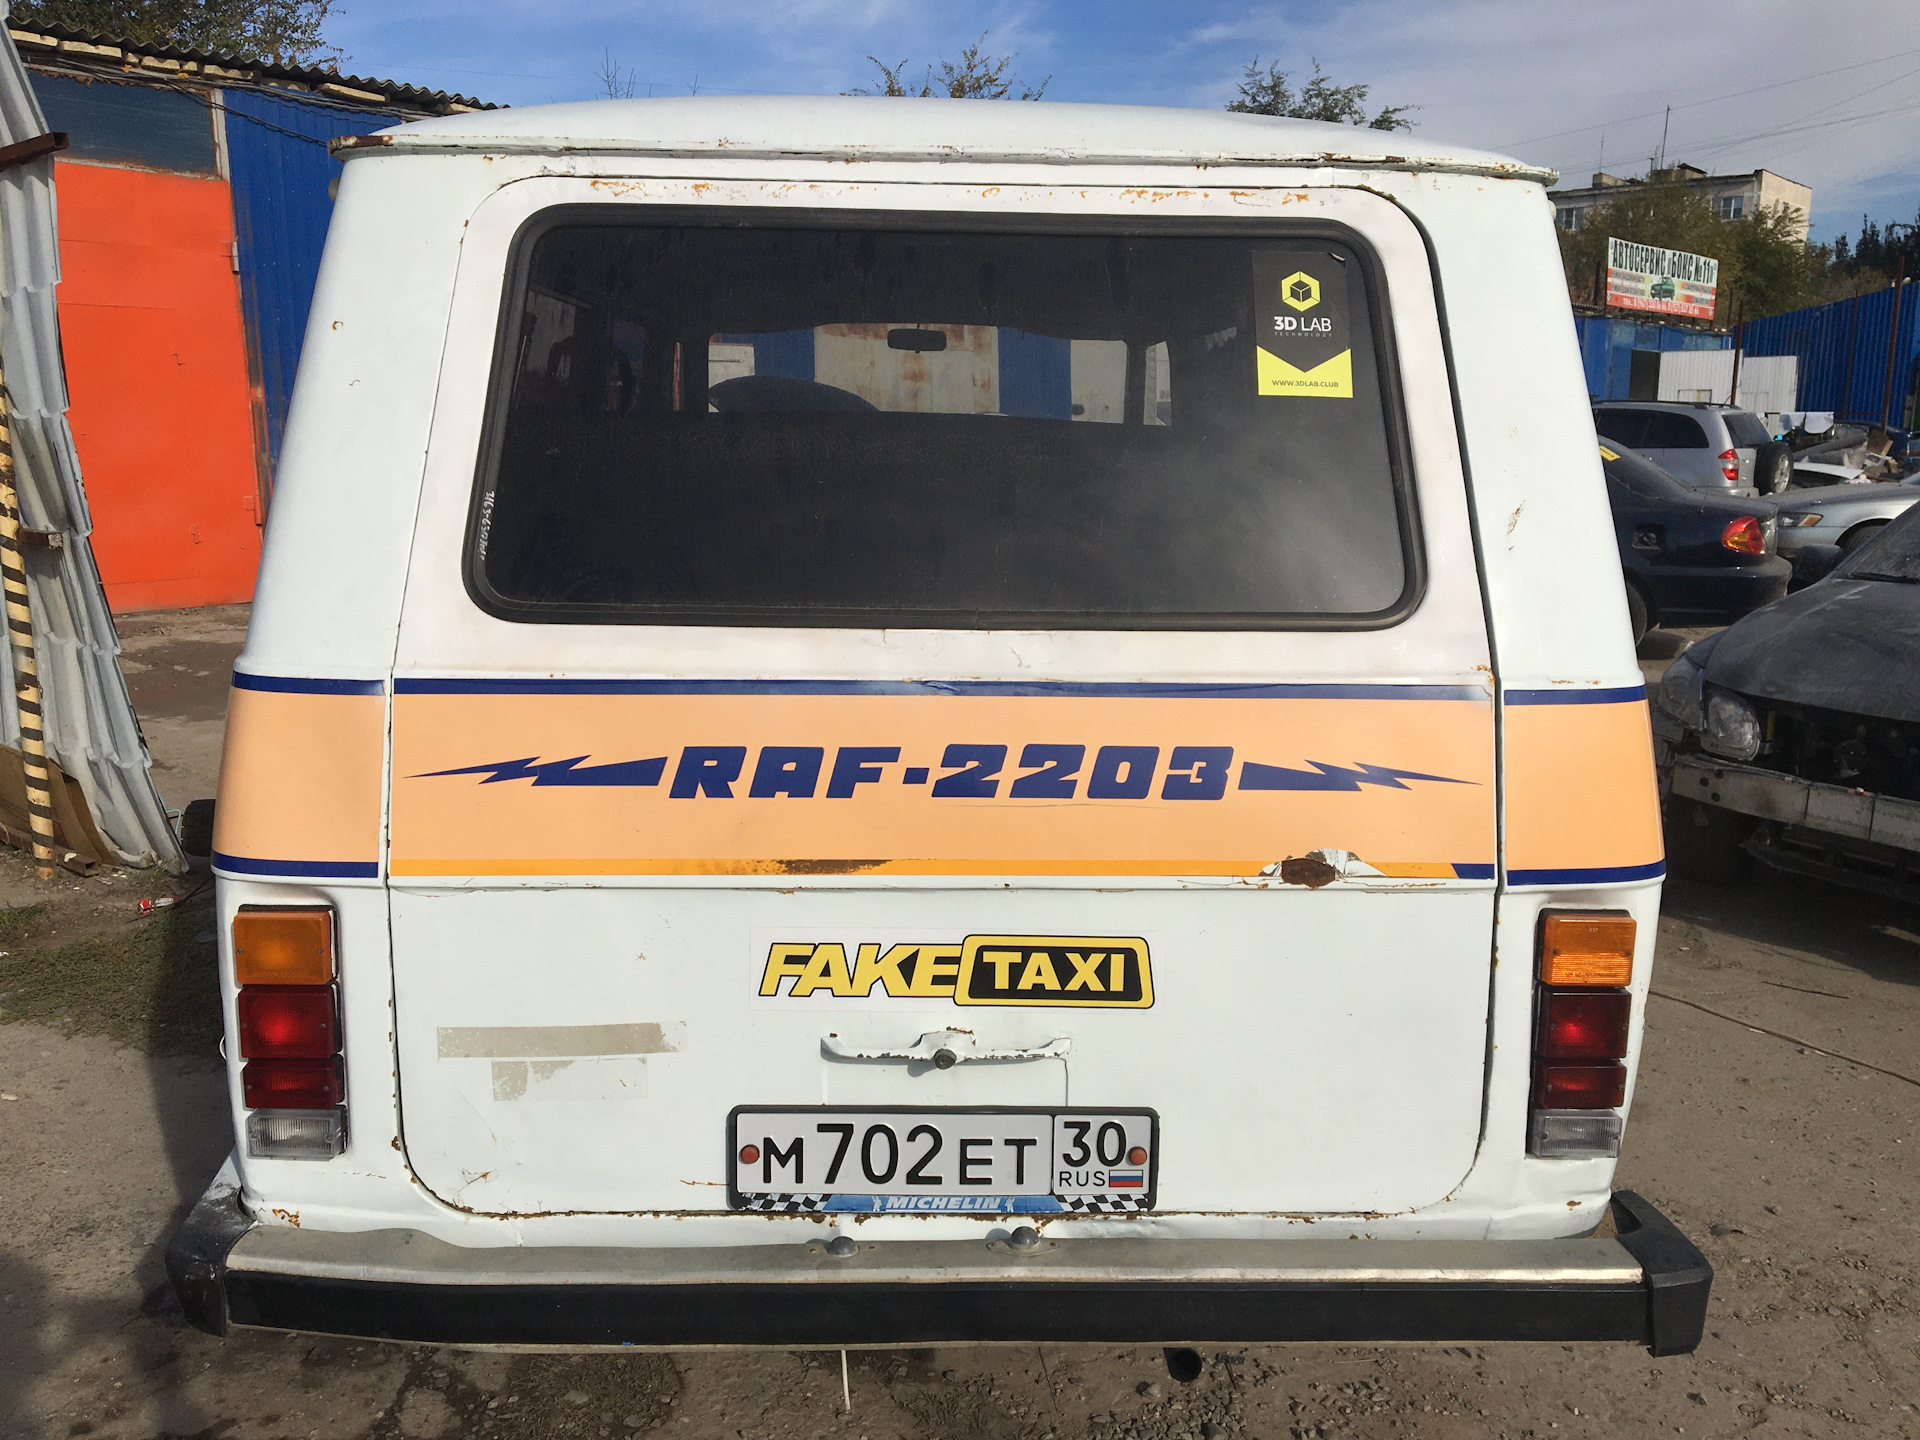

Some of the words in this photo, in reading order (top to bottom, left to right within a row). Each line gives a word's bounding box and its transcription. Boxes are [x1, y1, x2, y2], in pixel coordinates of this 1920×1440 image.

[1612, 240, 1667, 276] АВТОСЕРВИС
[1273, 316, 1297, 331] 3D
[1301, 317, 1332, 332] LAB
[1272, 380, 1339, 388] WWW.3DLAB.CLUB
[668, 743, 1235, 800] RAF-2203
[758, 943, 961, 998] FAKE
[982, 950, 1125, 993] TAXI
[1062, 1121, 1127, 1168] 30
[1059, 1170, 1106, 1187] RUS
[885, 1195, 1001, 1209] MICHELIN
